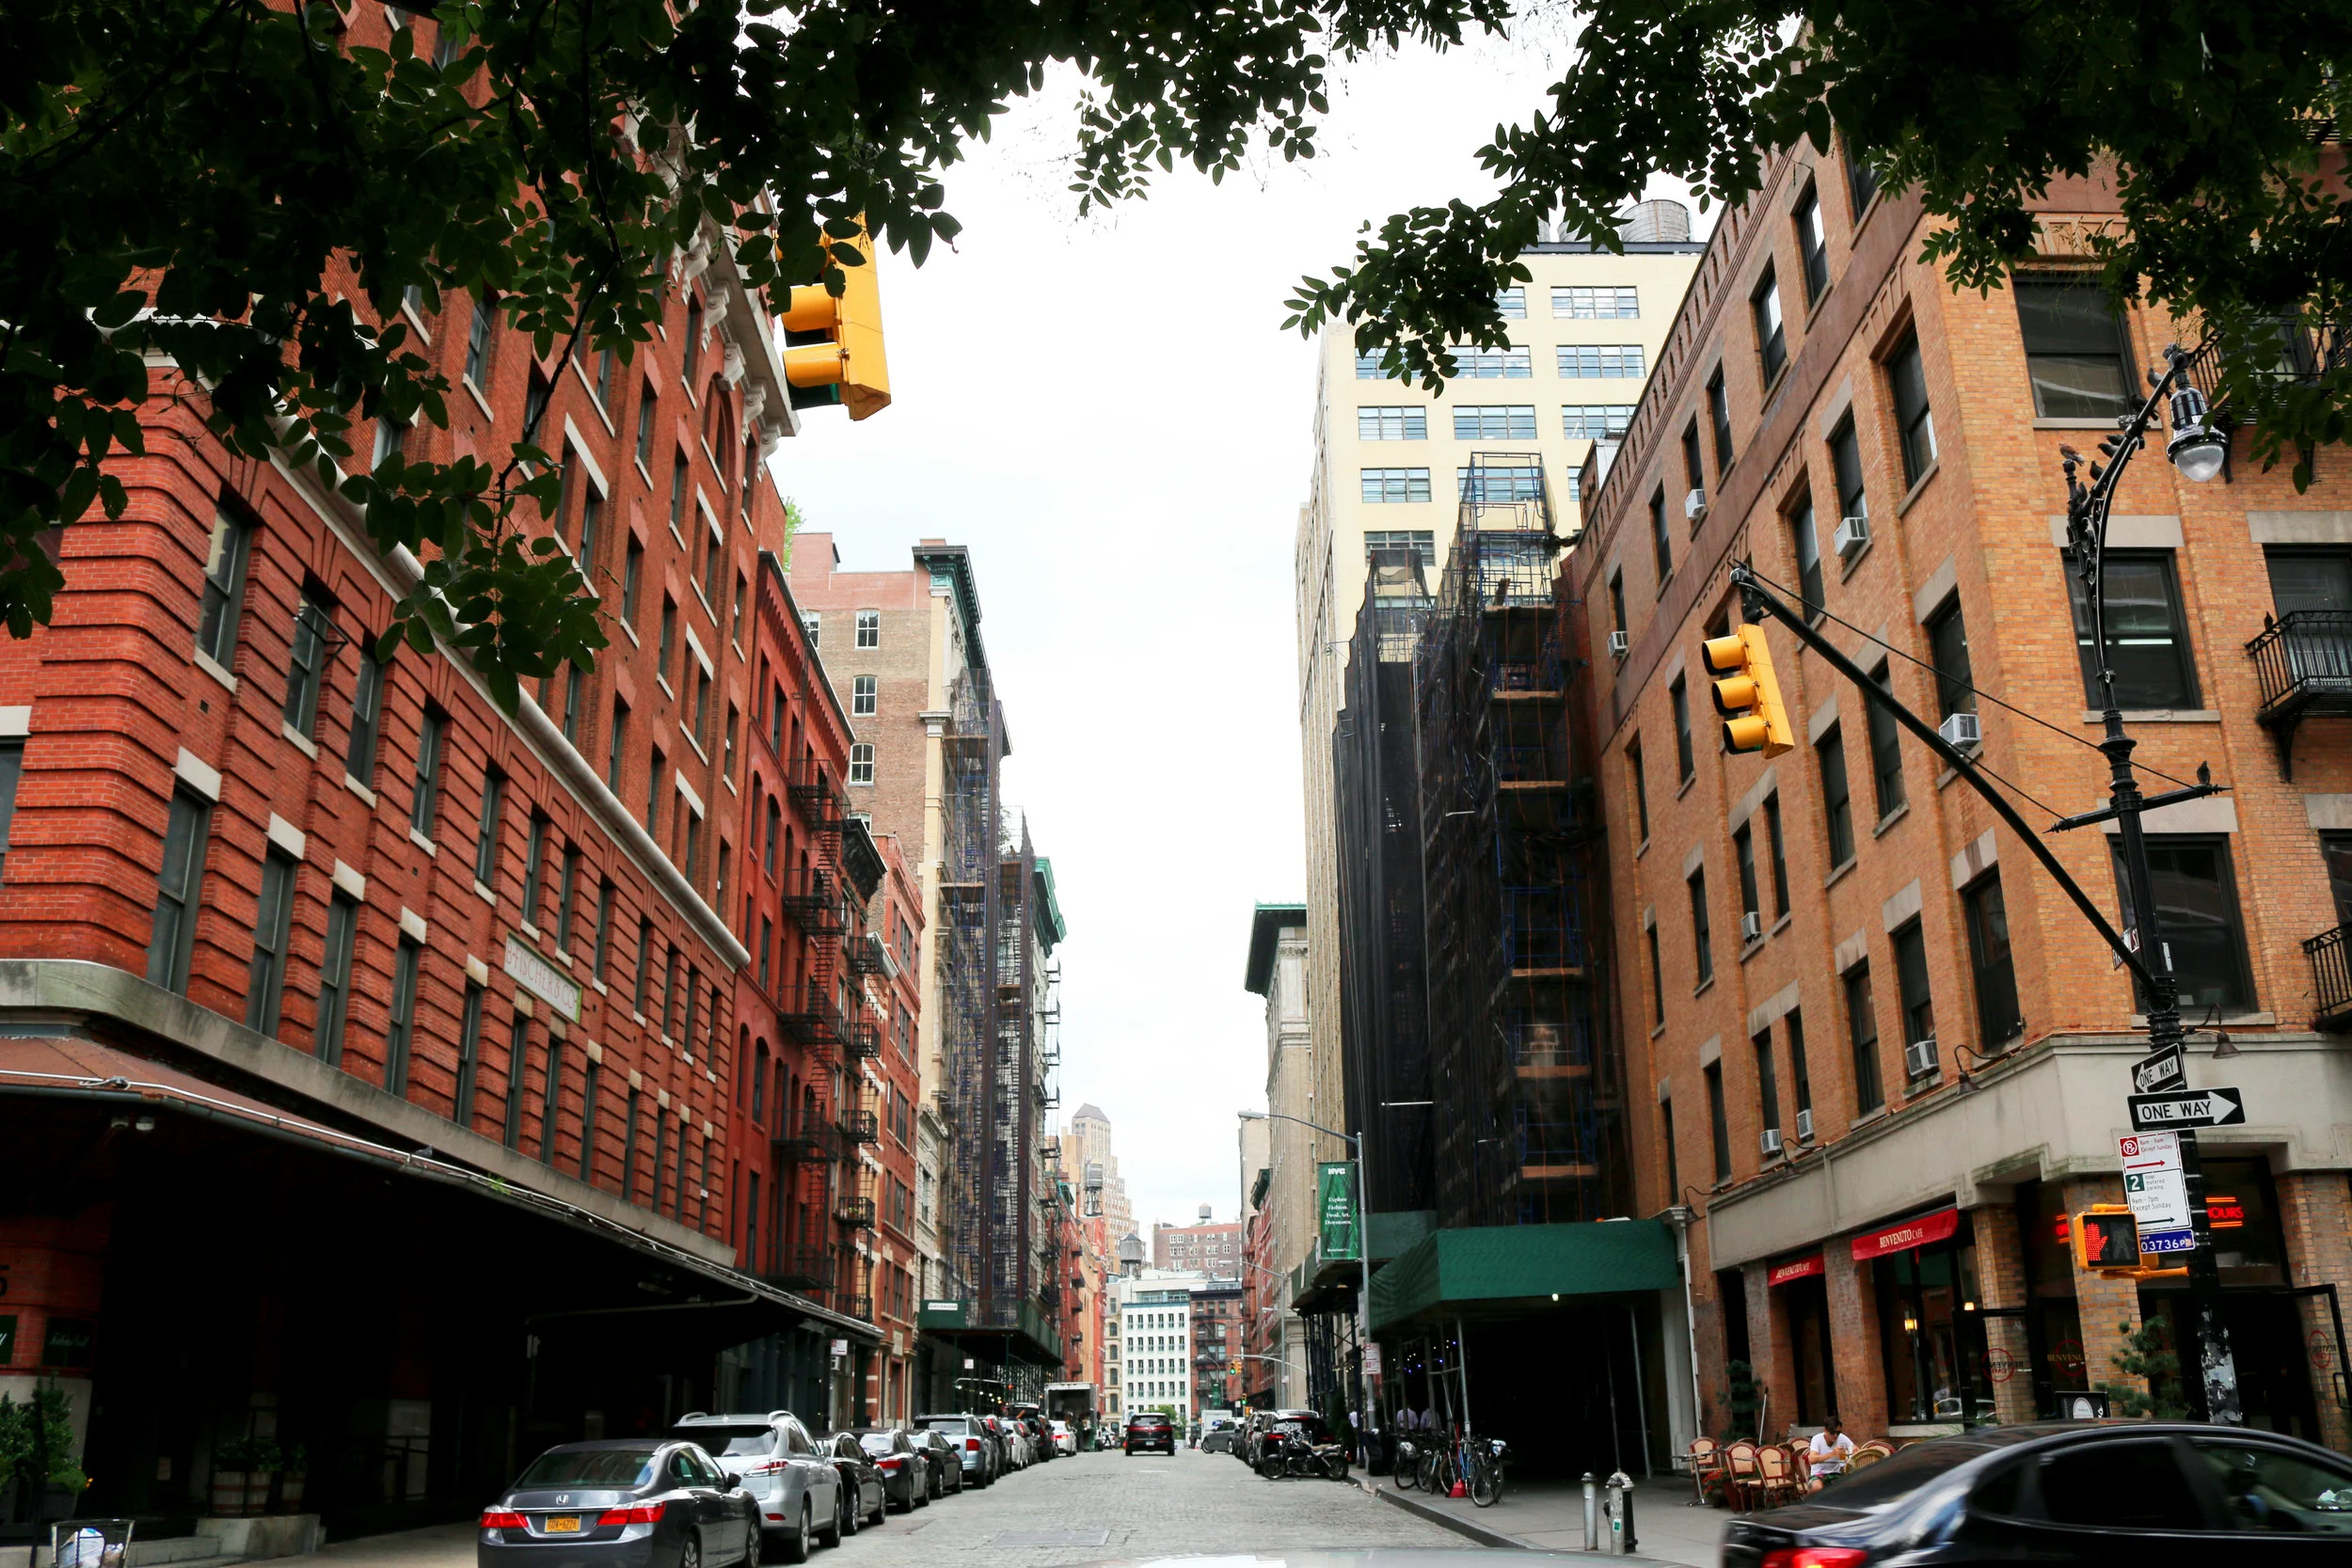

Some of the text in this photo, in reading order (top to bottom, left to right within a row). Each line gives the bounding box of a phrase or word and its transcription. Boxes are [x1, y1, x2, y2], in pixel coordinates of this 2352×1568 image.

[2139, 1058, 2174, 1087] ONE WAY
[2141, 1101, 2211, 1120] ONE WAY
[2130, 1175, 2141, 1191] 2
[1879, 1228, 1912, 1249] BENVENUTO
